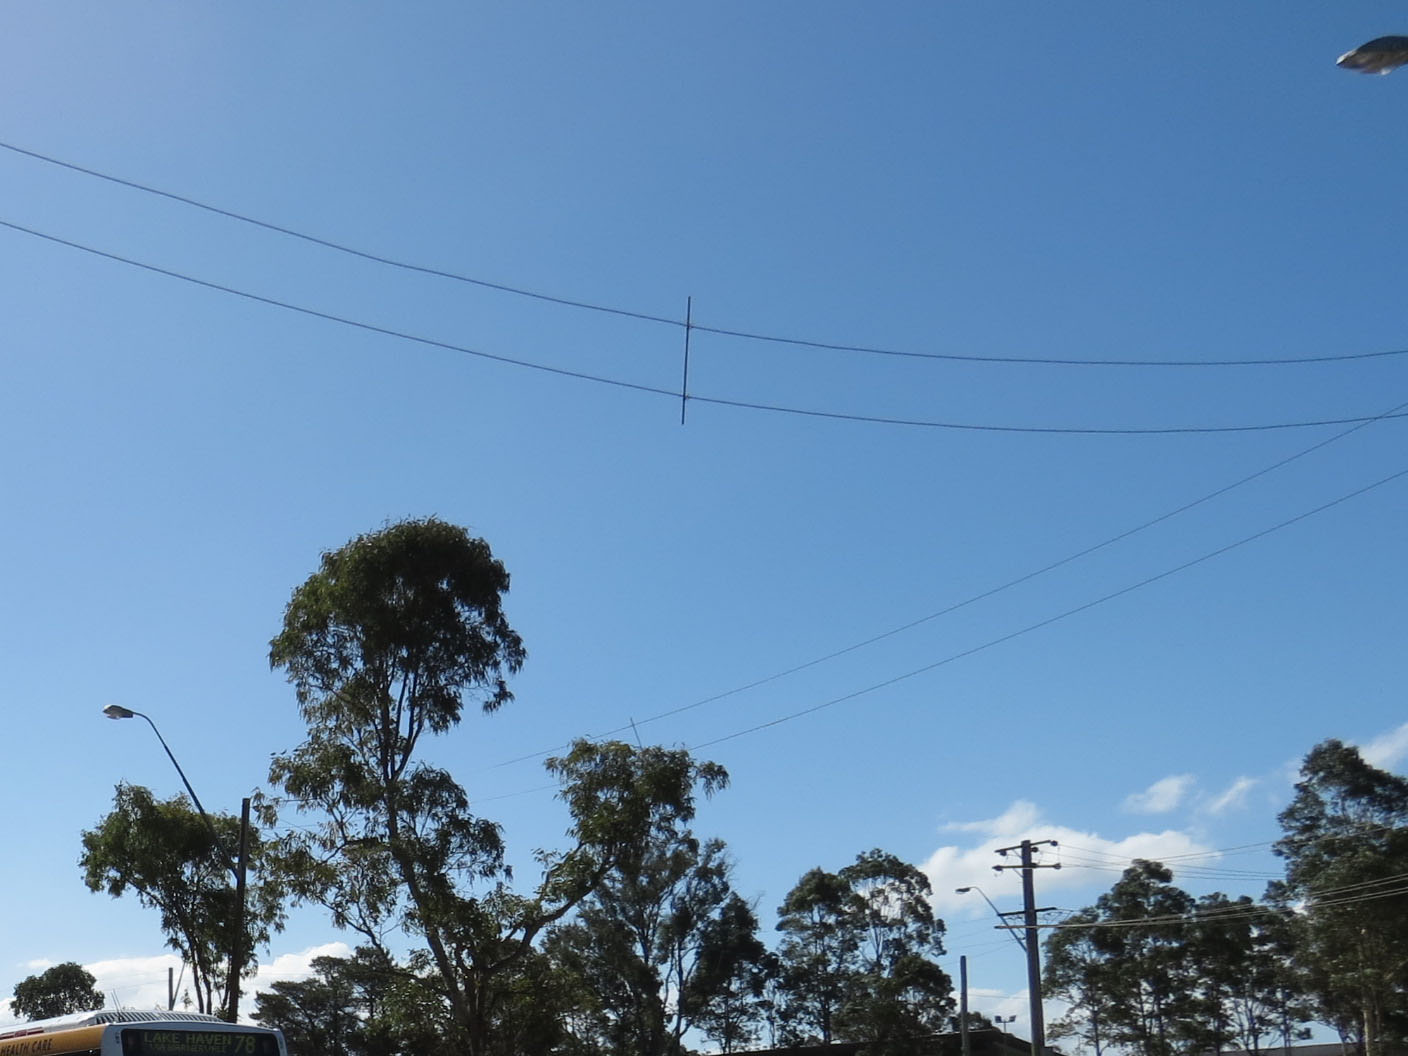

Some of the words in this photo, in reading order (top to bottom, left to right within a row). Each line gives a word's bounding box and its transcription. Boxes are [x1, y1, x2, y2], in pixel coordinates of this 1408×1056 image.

[0, 1042, 30, 1056] HEALTH
[31, 1038, 53, 1053] CARE
[143, 1032, 180, 1044] LAKE
[185, 1033, 232, 1045] HAVEN
[234, 1035, 256, 1054] 78
